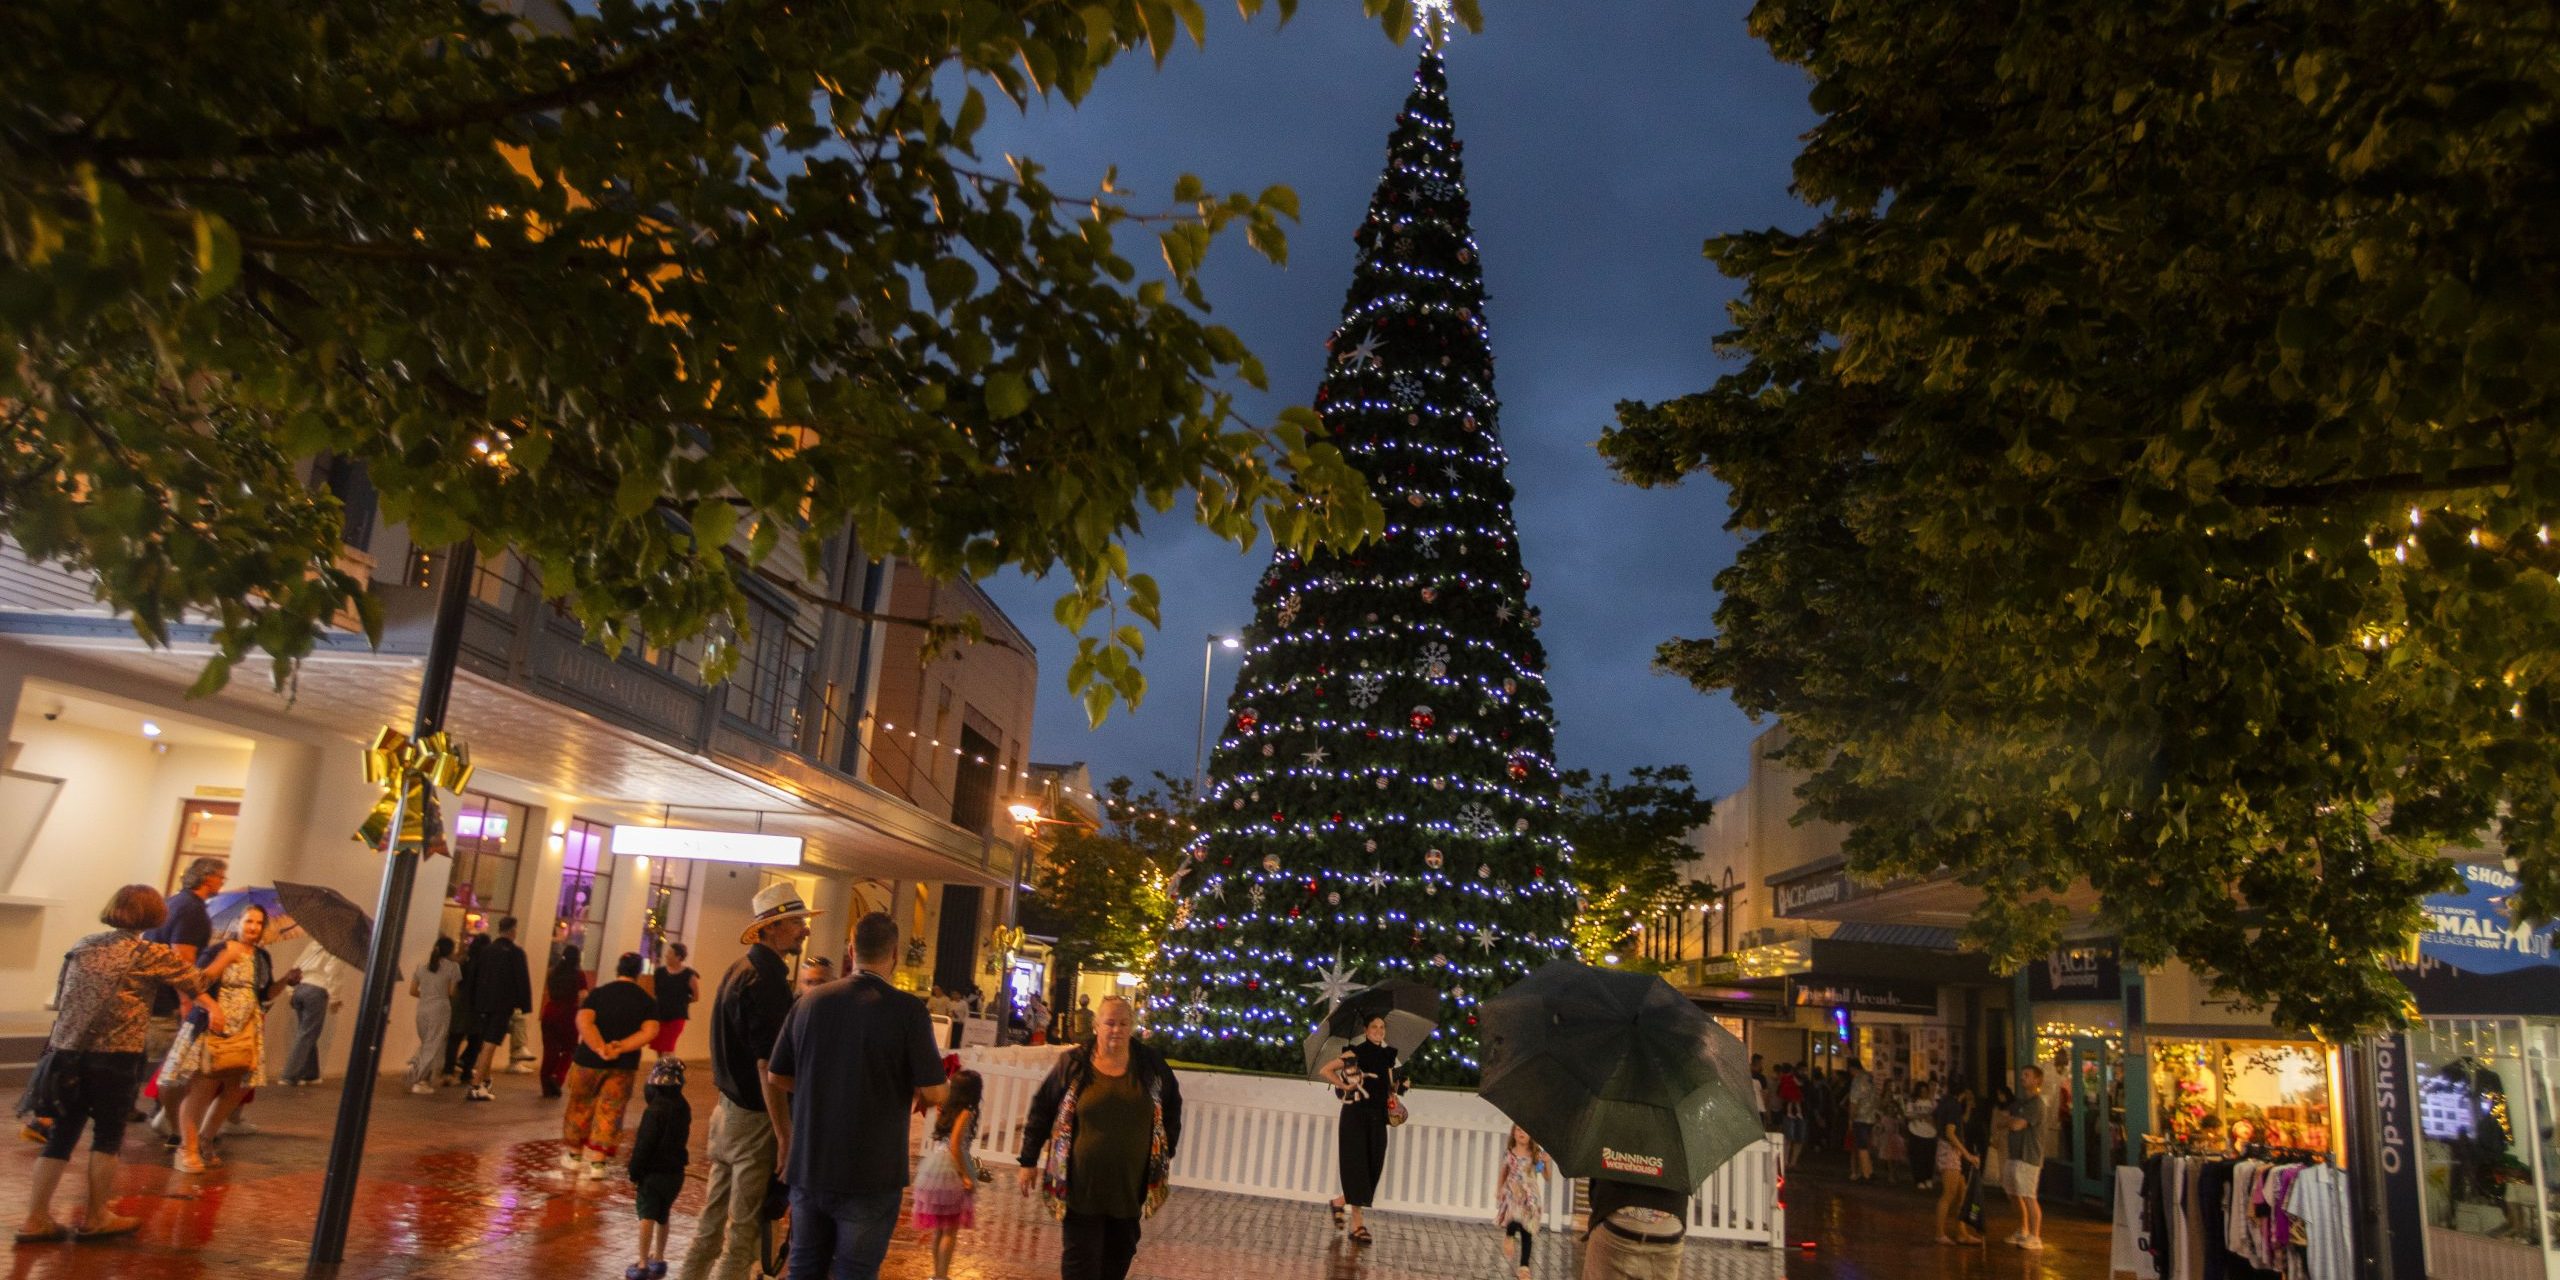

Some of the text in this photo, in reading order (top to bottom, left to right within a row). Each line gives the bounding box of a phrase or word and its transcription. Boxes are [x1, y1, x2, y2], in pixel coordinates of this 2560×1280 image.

[2466, 865, 2516, 889] SHOP
[1784, 883, 1806, 909] ACE
[2433, 934, 2475, 947] LEAGUE
[2060, 947, 2098, 972] ACE
[1853, 988, 1901, 1006] Arcade
[1602, 1147, 1664, 1168] BUNNINGS
[1605, 1159, 1659, 1175] warehouse
